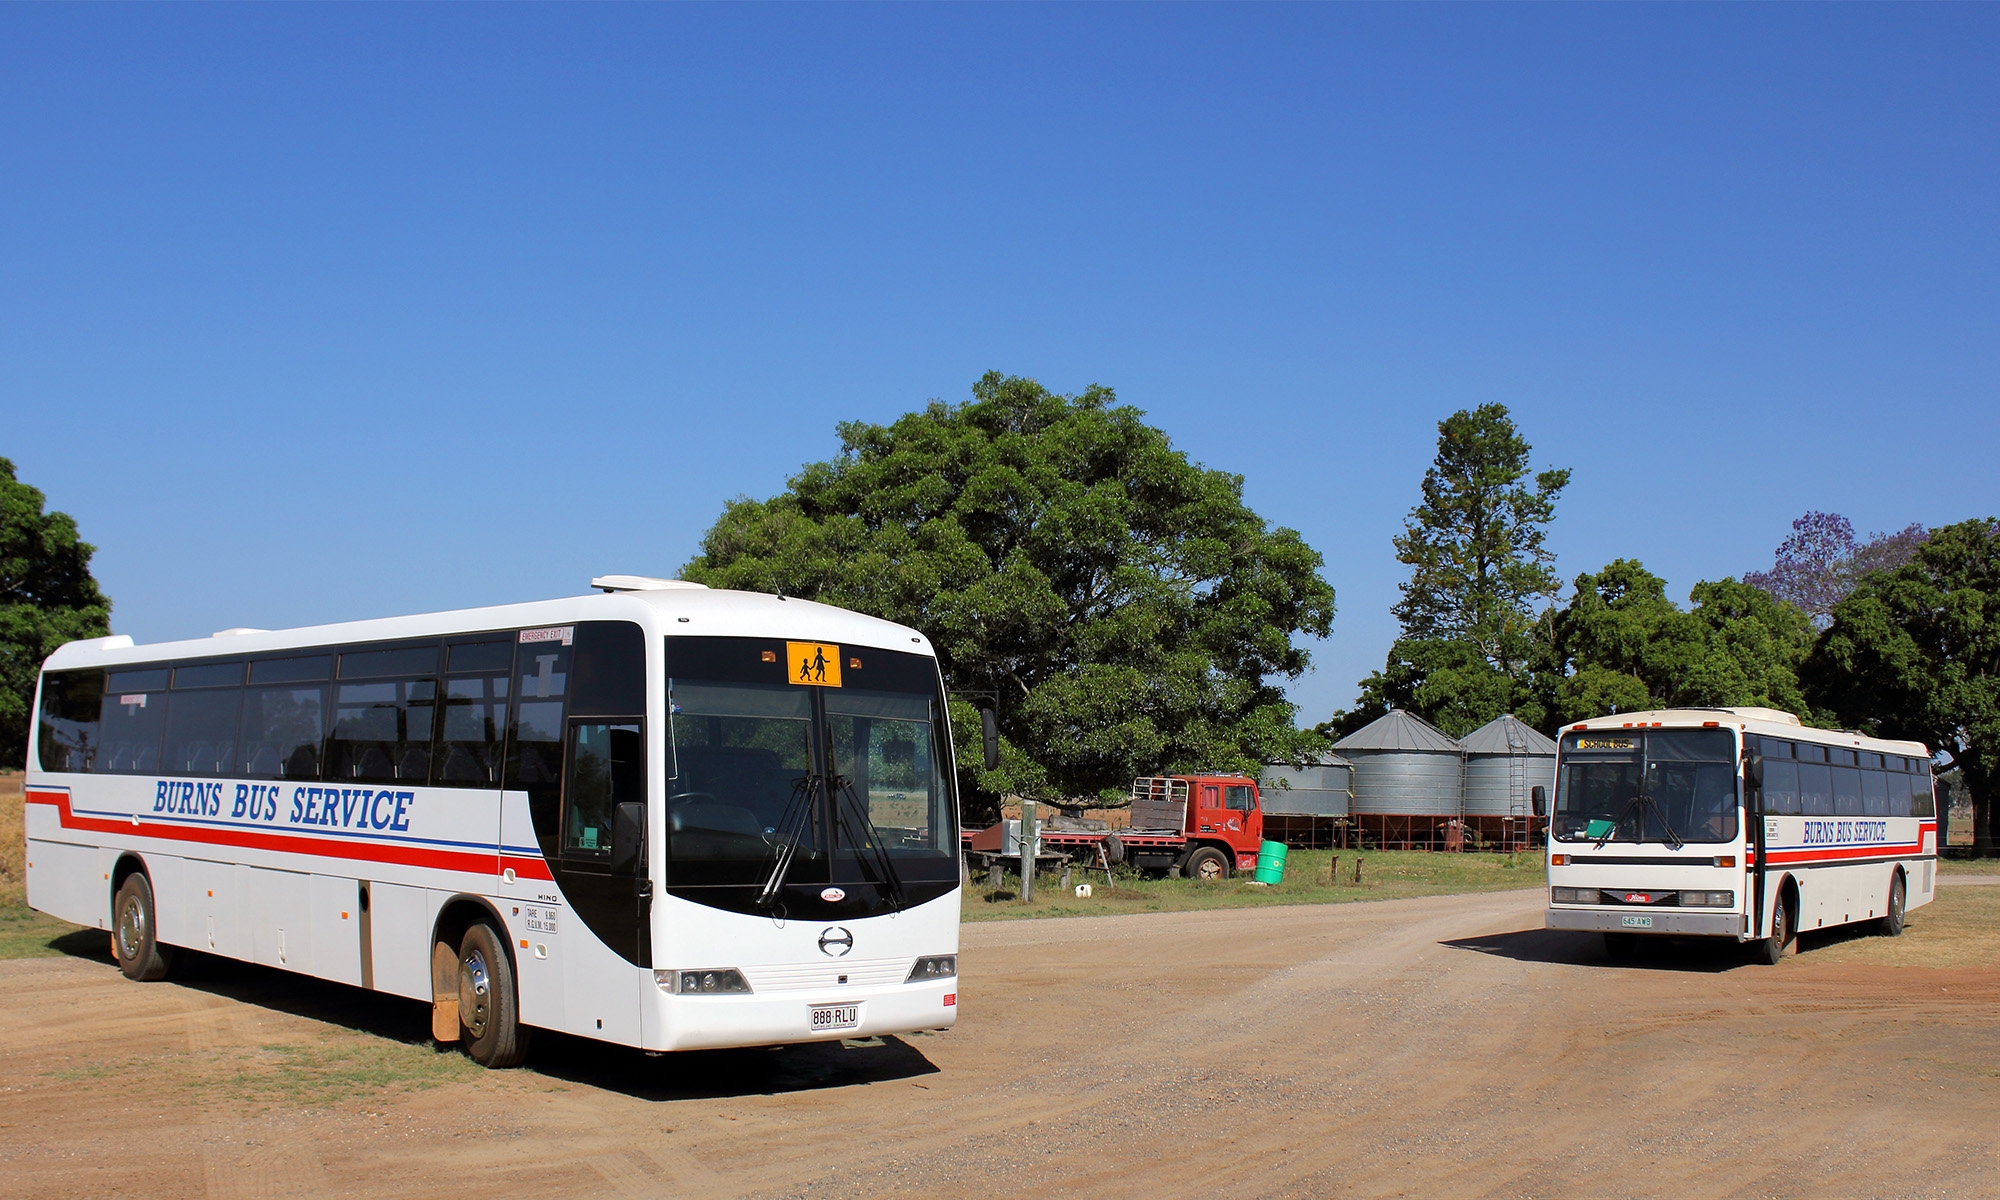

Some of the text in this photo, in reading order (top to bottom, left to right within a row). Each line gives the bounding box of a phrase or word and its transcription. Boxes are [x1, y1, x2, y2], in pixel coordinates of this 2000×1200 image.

[522, 629, 561, 640] EMERGENCY EXIT
[1584, 738, 1629, 748] SCHOOL BUS
[153, 781, 415, 832] BURNS BUS SERVICE
[1803, 821, 1834, 843] BURNS
[1836, 821, 1852, 842] BUS
[1854, 821, 1886, 841] SERVICE
[537, 894, 557, 902] HINO
[527, 908, 537, 918] TARE
